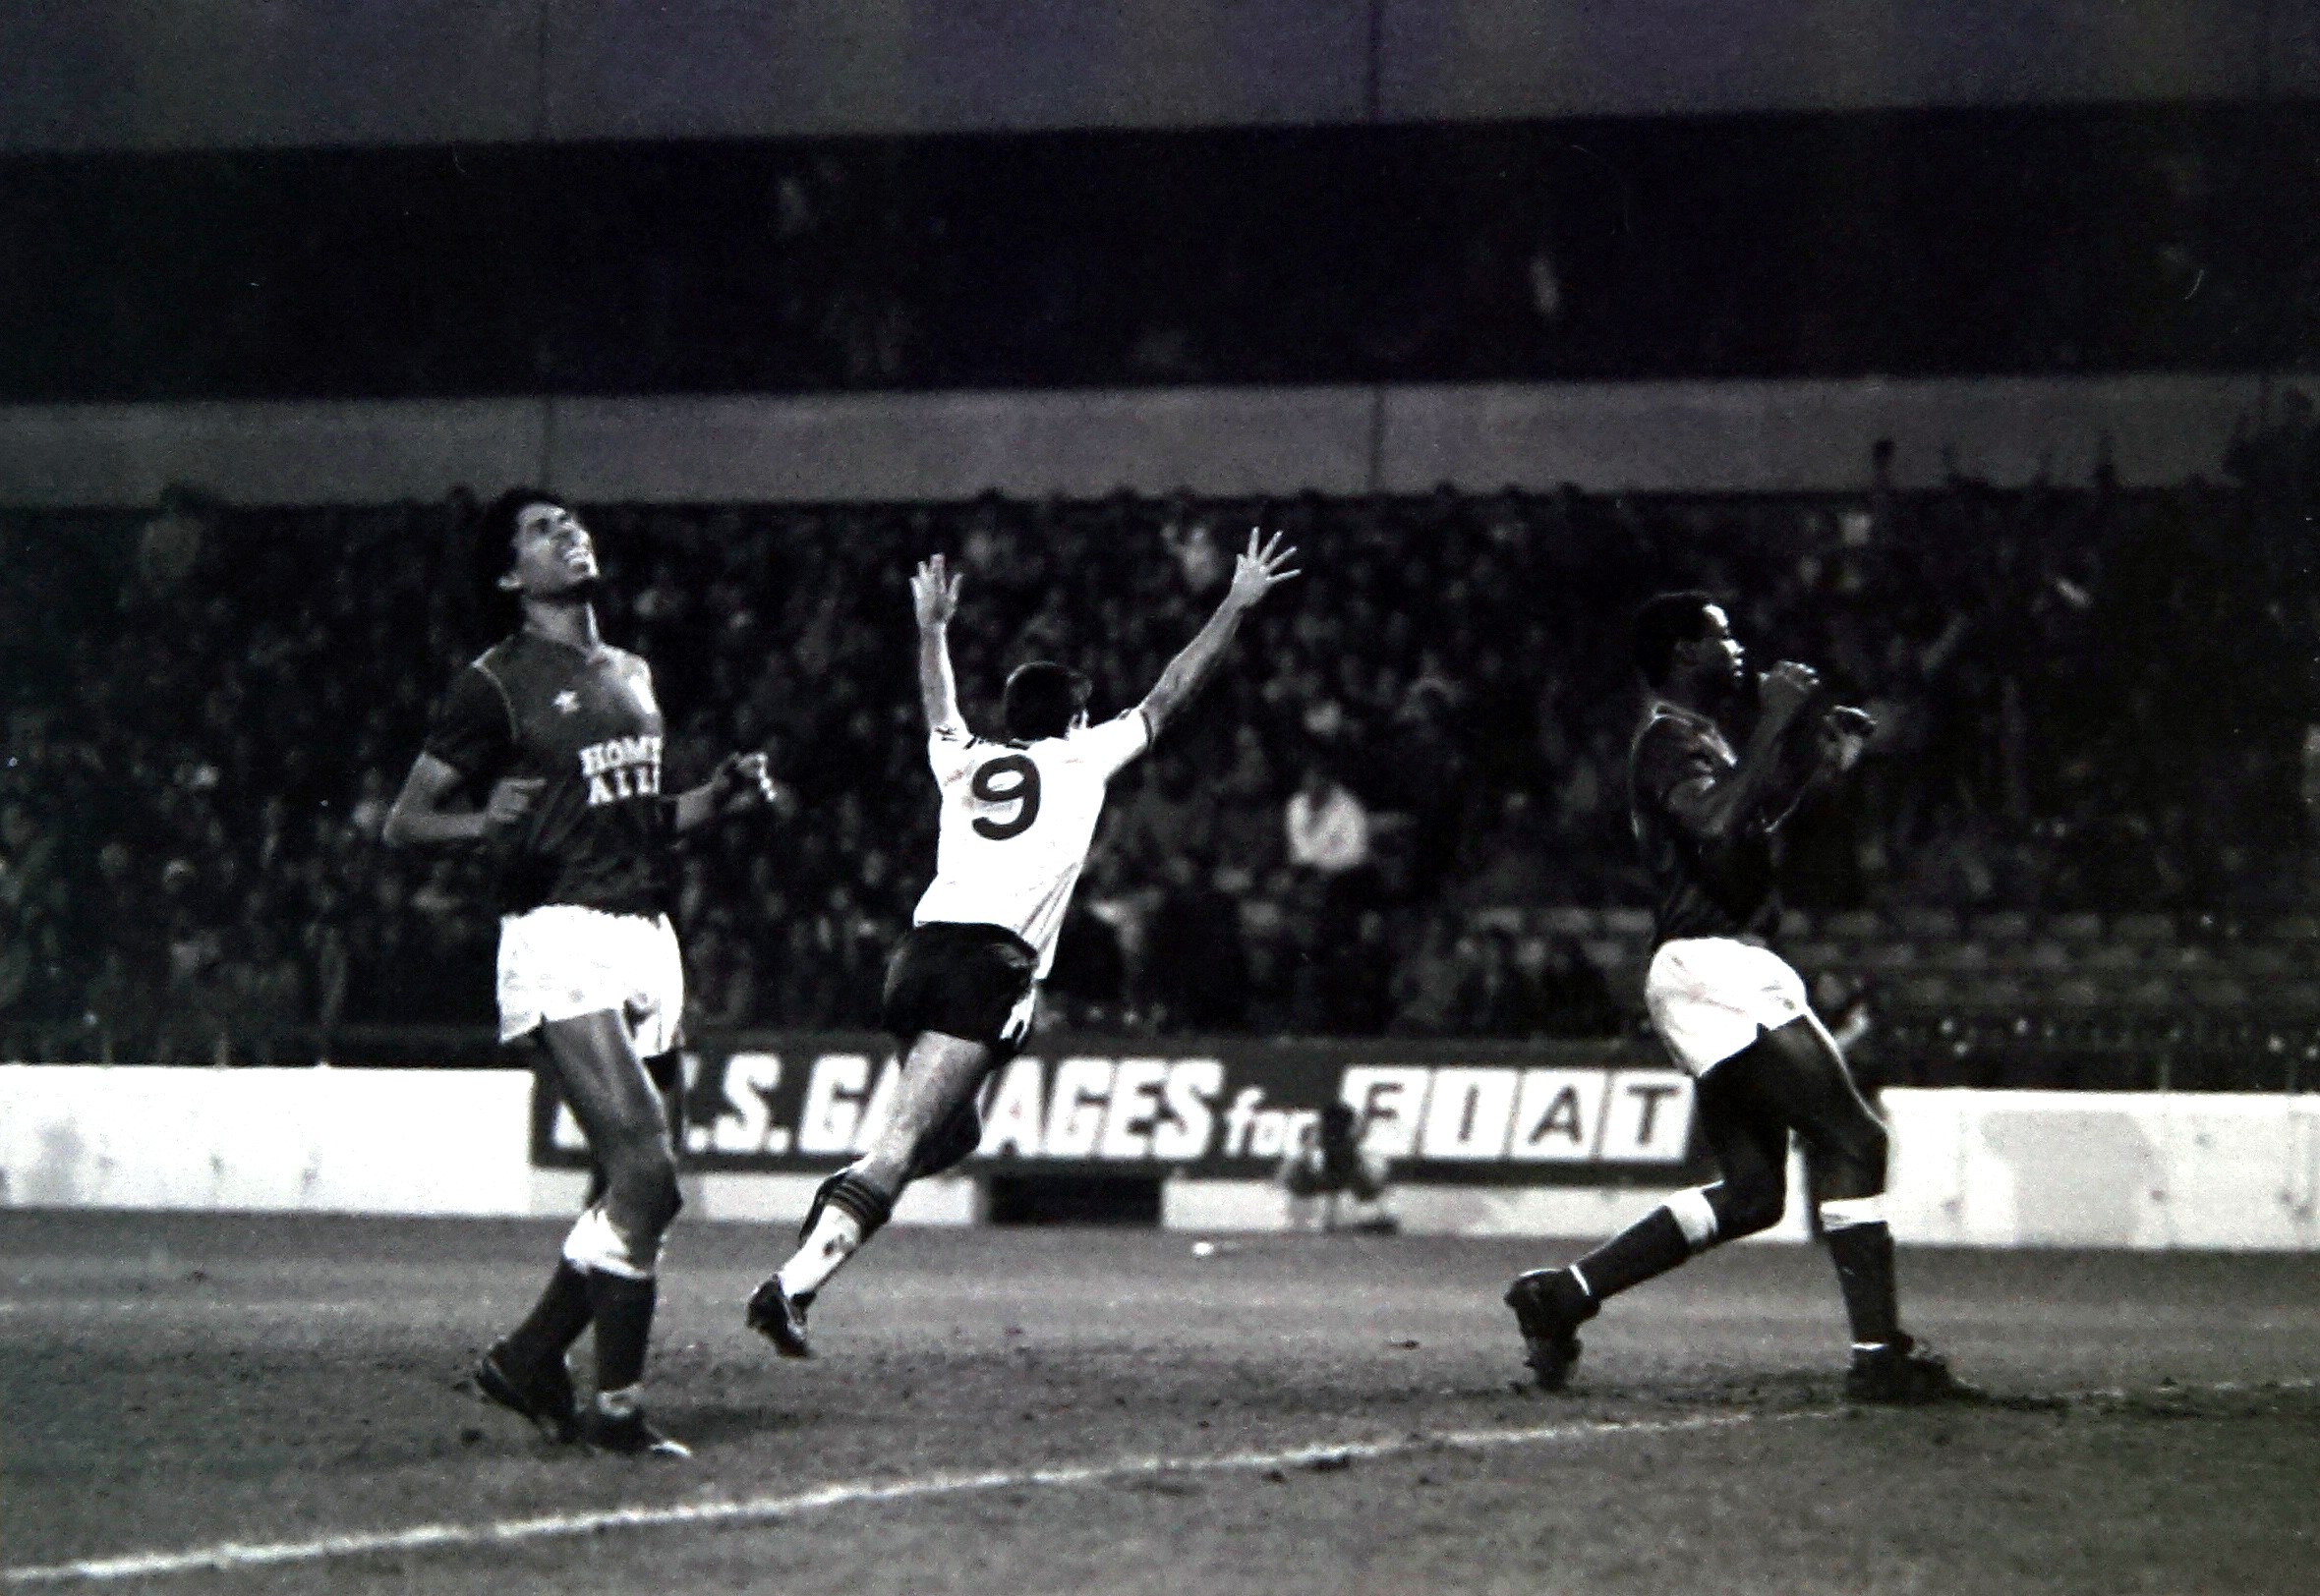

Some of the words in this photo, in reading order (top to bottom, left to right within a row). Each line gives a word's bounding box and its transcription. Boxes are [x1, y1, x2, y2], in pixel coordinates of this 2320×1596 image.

[971, 754, 1041, 840] 9
[798, 1054, 1225, 1161] GAGES
[1224, 1086, 1319, 1159] for
[1359, 1080, 1680, 1146] FIAT
